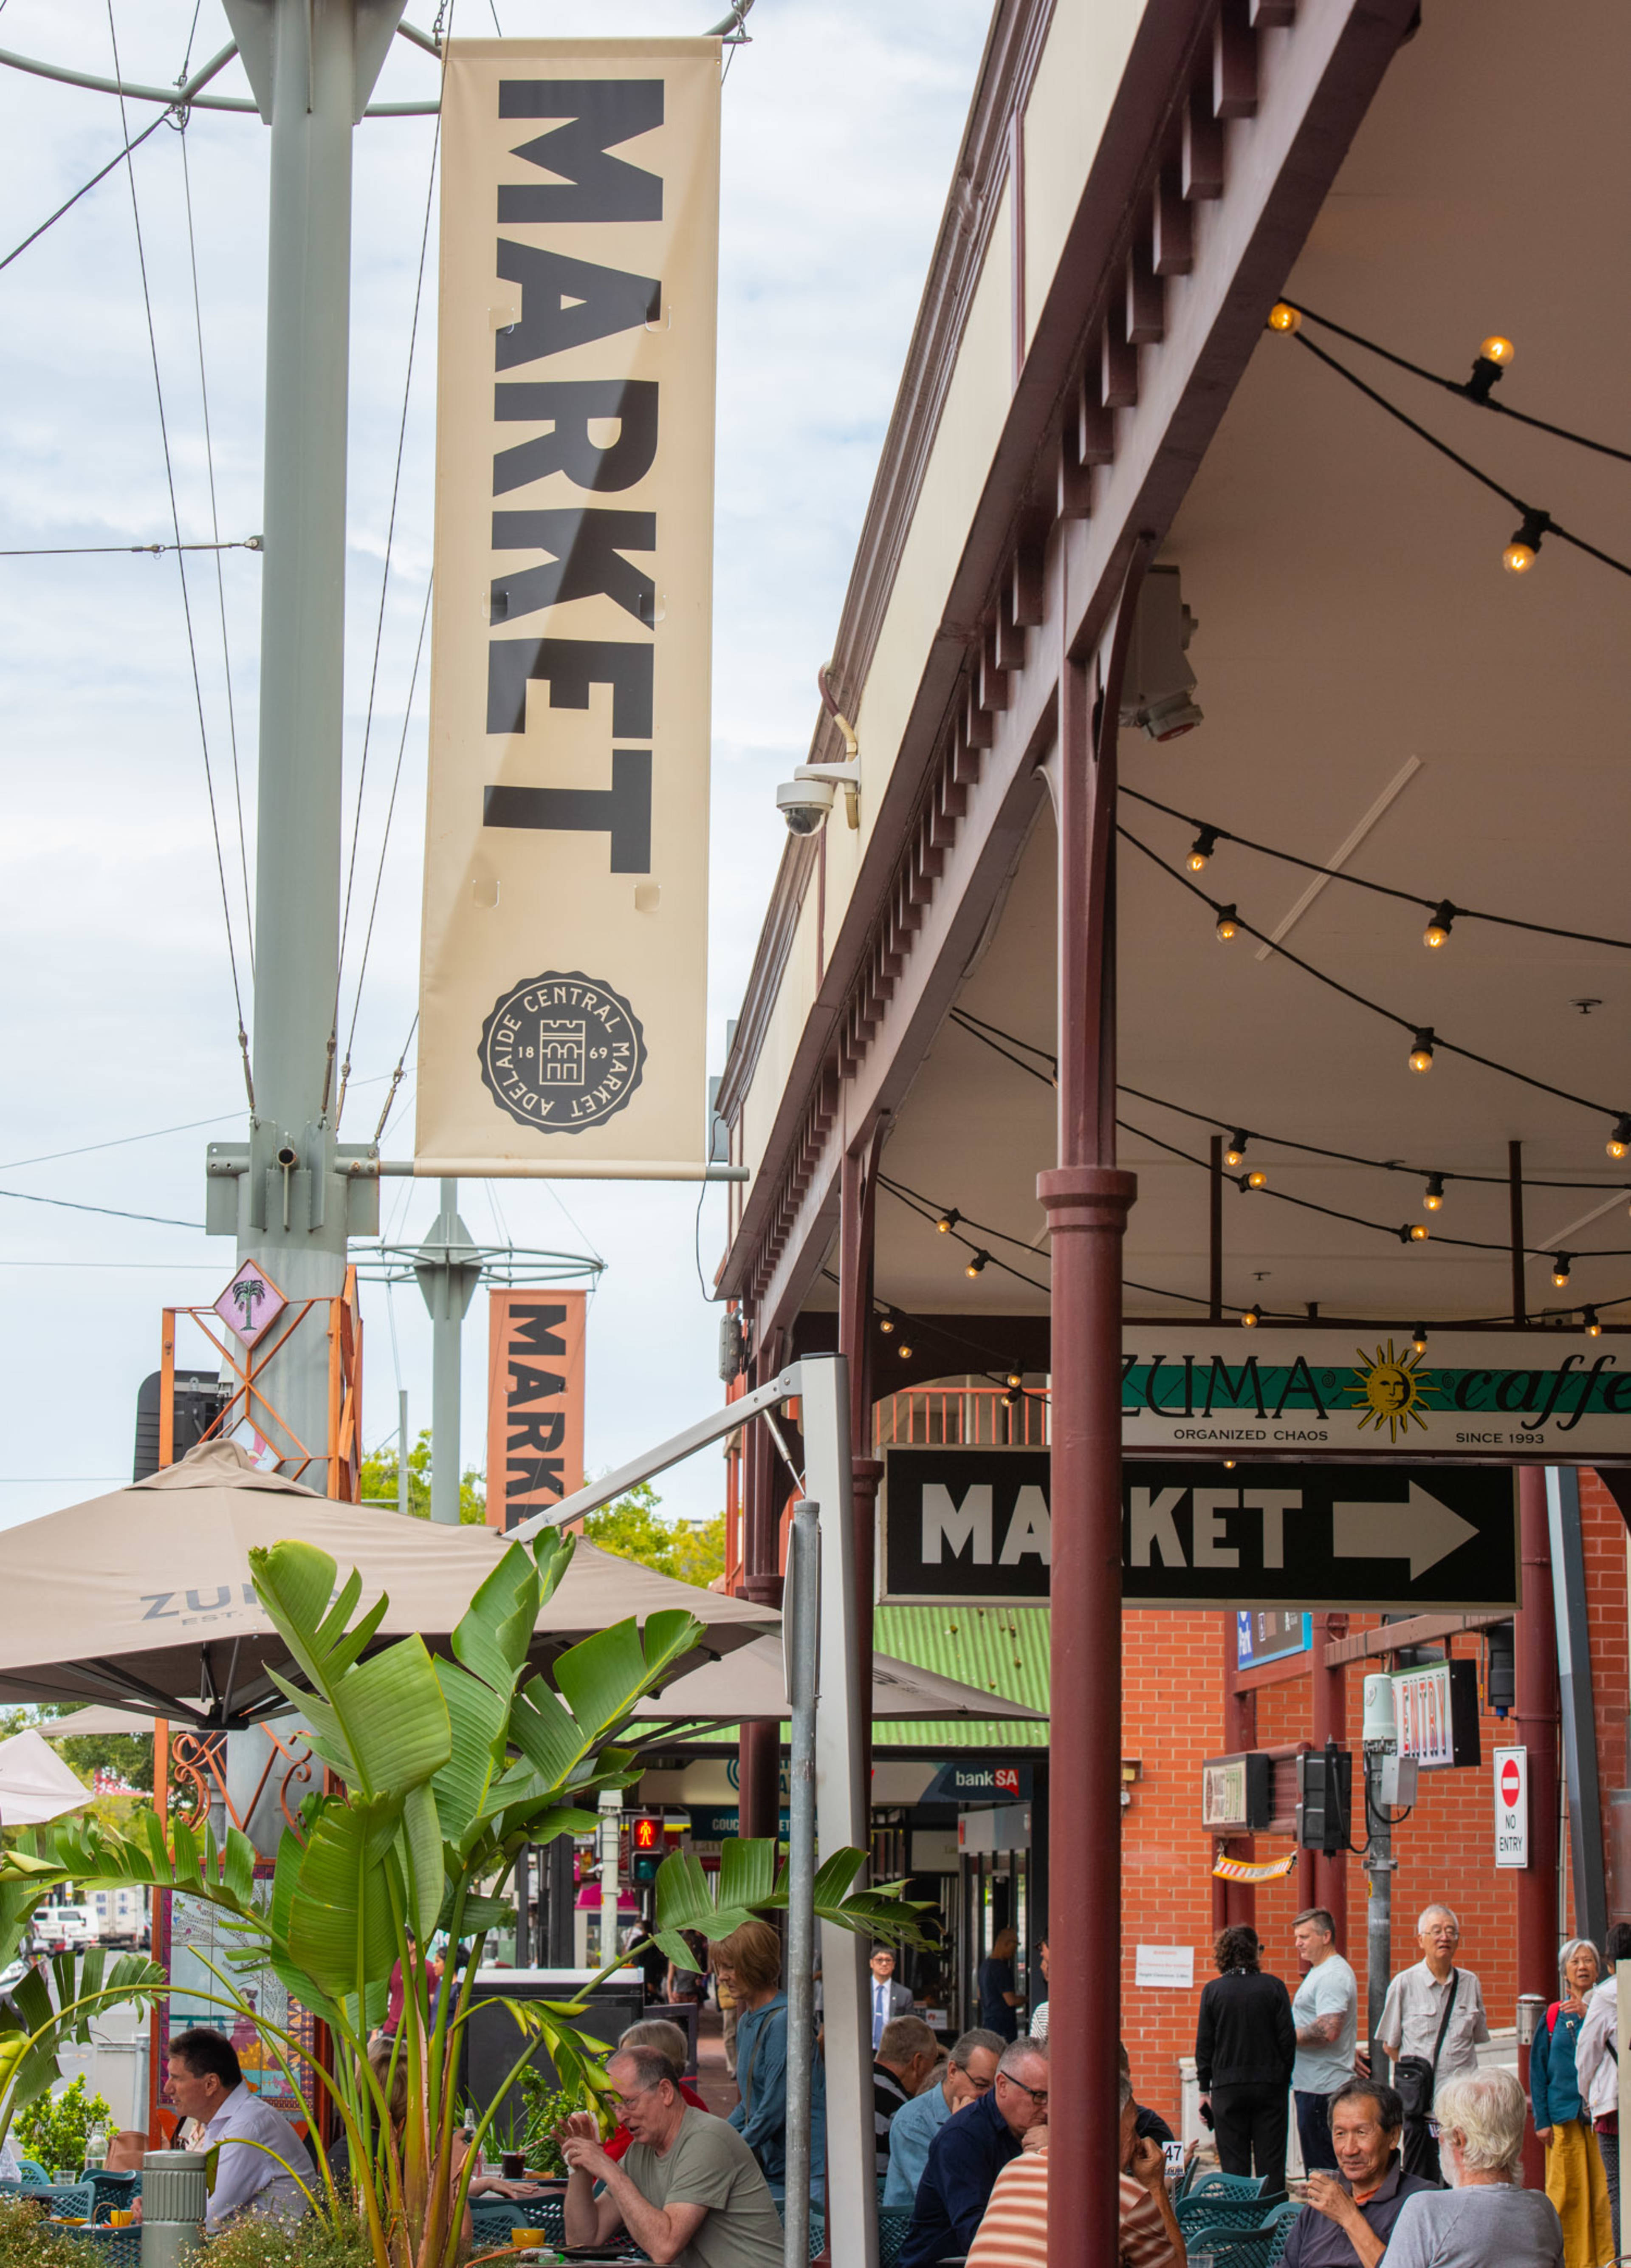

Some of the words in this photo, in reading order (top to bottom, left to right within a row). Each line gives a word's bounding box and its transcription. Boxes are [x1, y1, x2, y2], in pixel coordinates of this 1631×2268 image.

[483, 79, 664, 873] MARKET
[523, 986, 622, 1033] CENTRAL
[518, 1047, 534, 1058] 18
[589, 1047, 607, 1059] 69
[495, 1014, 555, 1117] ADELAIDE
[570, 1041, 630, 1118] MARKET
[1174, 1429, 1266, 1440] ORGANIZED
[1273, 1430, 1328, 1441] CHAOS
[1456, 1432, 1503, 1443] SINCE
[1509, 1433, 1544, 1444] 1993
[922, 1483, 1302, 1568] MAKET
[182, 1610, 243, 1626] EST.
[1402, 1674, 1447, 1757] ENTRY
[956, 1769, 1017, 1786] bankSA
[1505, 1814, 1516, 1830] NO
[1499, 1836, 1522, 1852] ENTRY
[1165, 2144, 1182, 2161] 47
